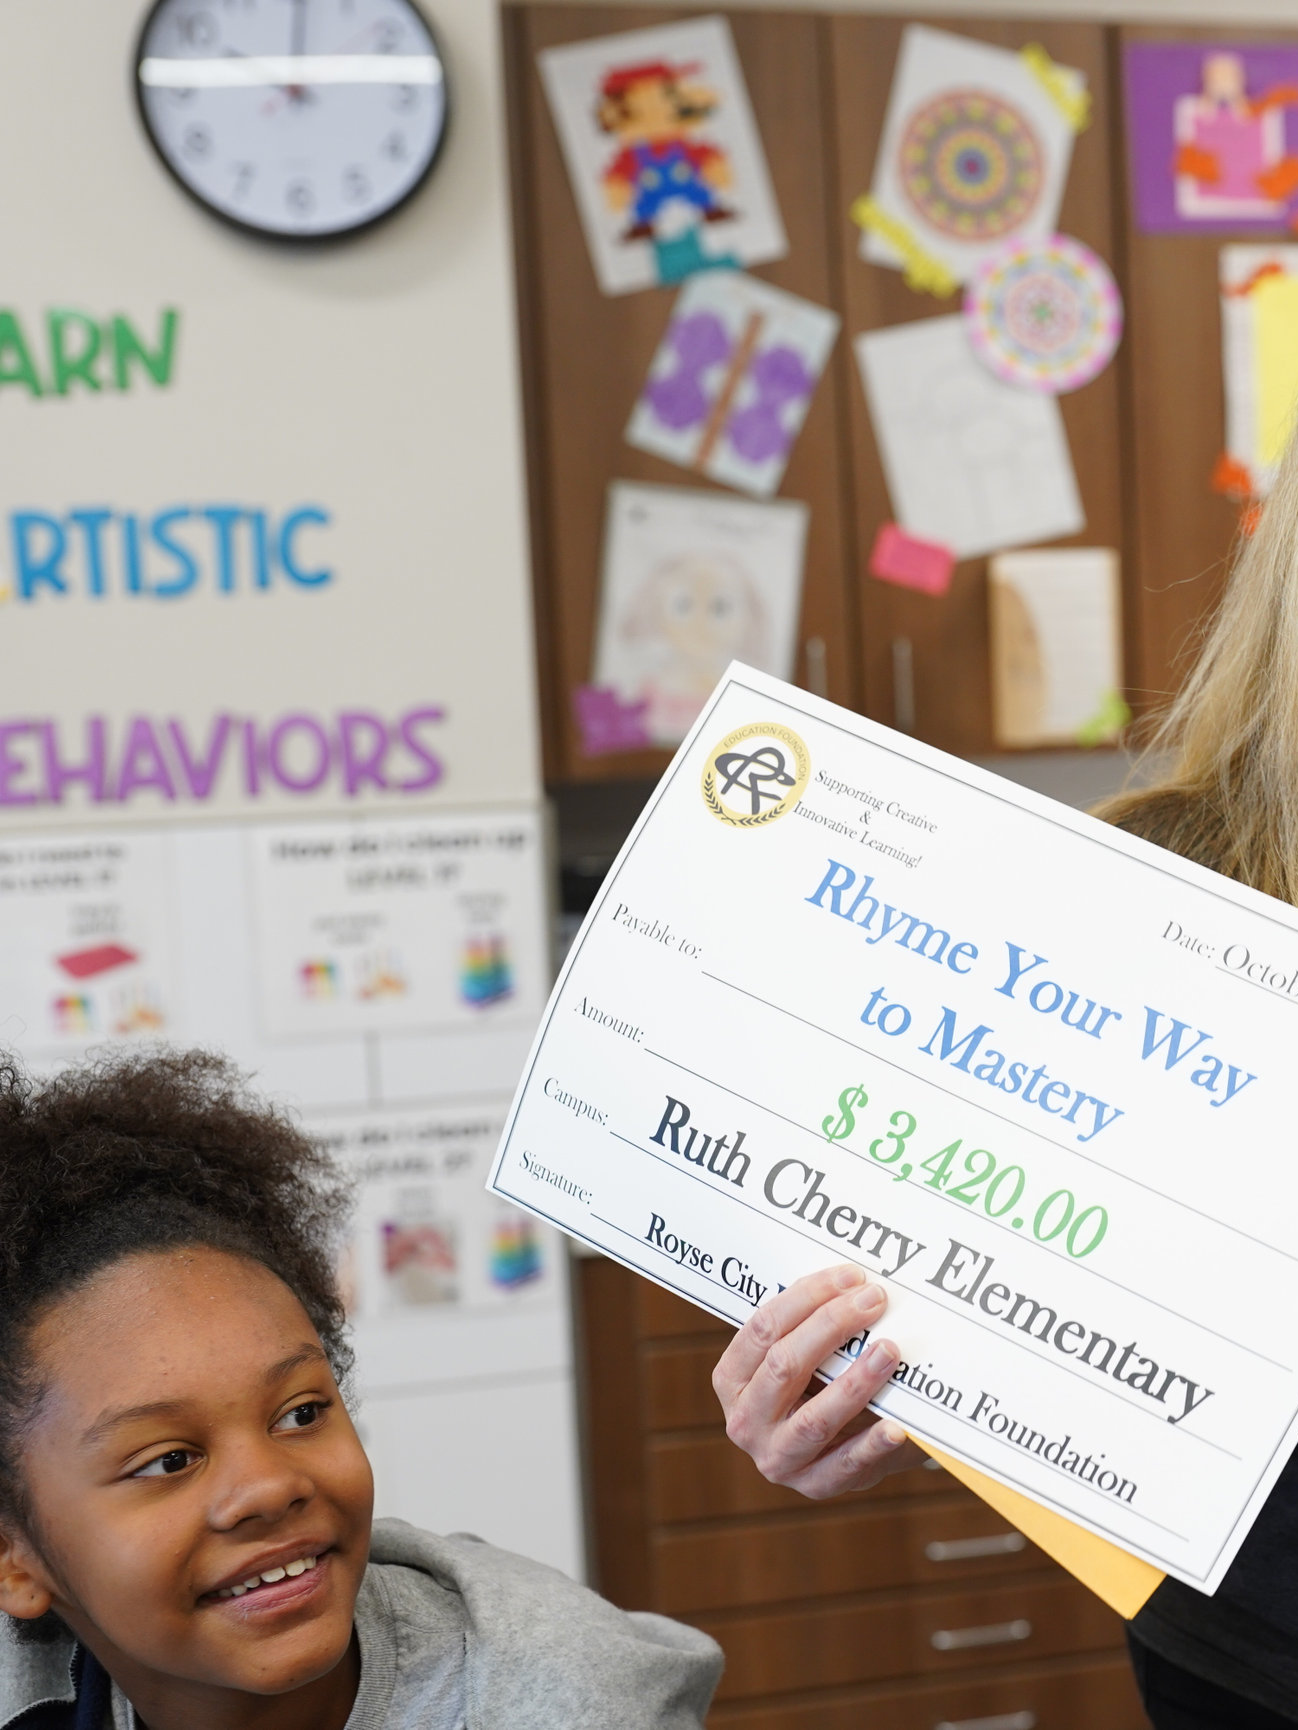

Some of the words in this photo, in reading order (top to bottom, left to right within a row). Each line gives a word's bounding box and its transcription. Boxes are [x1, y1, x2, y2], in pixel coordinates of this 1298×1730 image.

[723, 726, 777, 749] EDUCATION
[778, 729, 807, 781] FOUNDATION
[814, 769, 884, 812] Supporting
[886, 800, 938, 834] Creative
[859, 810, 873, 826] &
[792, 800, 858, 840] Innovative
[859, 831, 923, 869] Learning!
[611, 902, 676, 947] Payable
[677, 938, 703, 960] to:
[1161, 920, 1216, 959] Date:
[803, 857, 980, 976] Rhyme
[994, 940, 1124, 1041] Your
[1137, 1005, 1258, 1109] Way
[573, 996, 645, 1044] Amount:
[859, 985, 912, 1037] to
[917, 1005, 1125, 1143] Mastery
[543, 1076, 609, 1127] Campus:
[518, 1150, 593, 1206] Signature:
[644, 1211, 714, 1274] Royse
[720, 1255, 768, 1307] City
[648, 1095, 752, 1189] Ruth
[762, 1157, 927, 1279] Cherry
[924, 1237, 1216, 1426] Elementary
[966, 1390, 1139, 1504] Foundation
